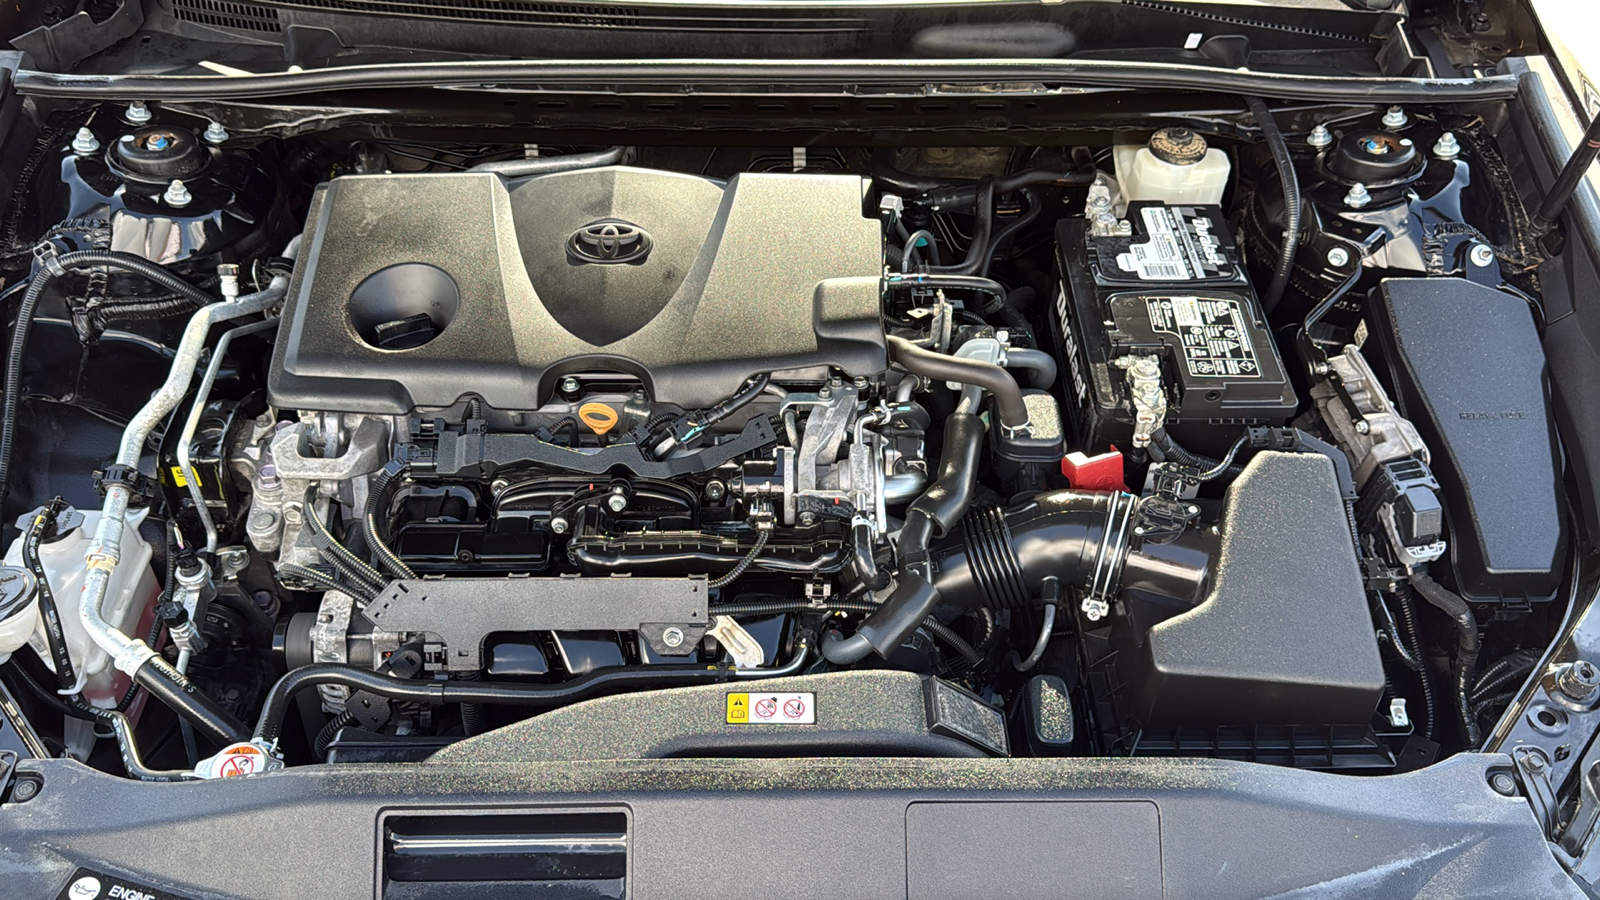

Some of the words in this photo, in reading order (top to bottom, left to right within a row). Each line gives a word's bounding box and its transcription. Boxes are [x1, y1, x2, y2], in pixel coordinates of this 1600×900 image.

[1183, 230, 1198, 263] TECHNOLOGY
[1192, 216, 1225, 266] Duralast
[1056, 279, 1086, 408] Duralast
[1458, 412, 1489, 420] RELAY
